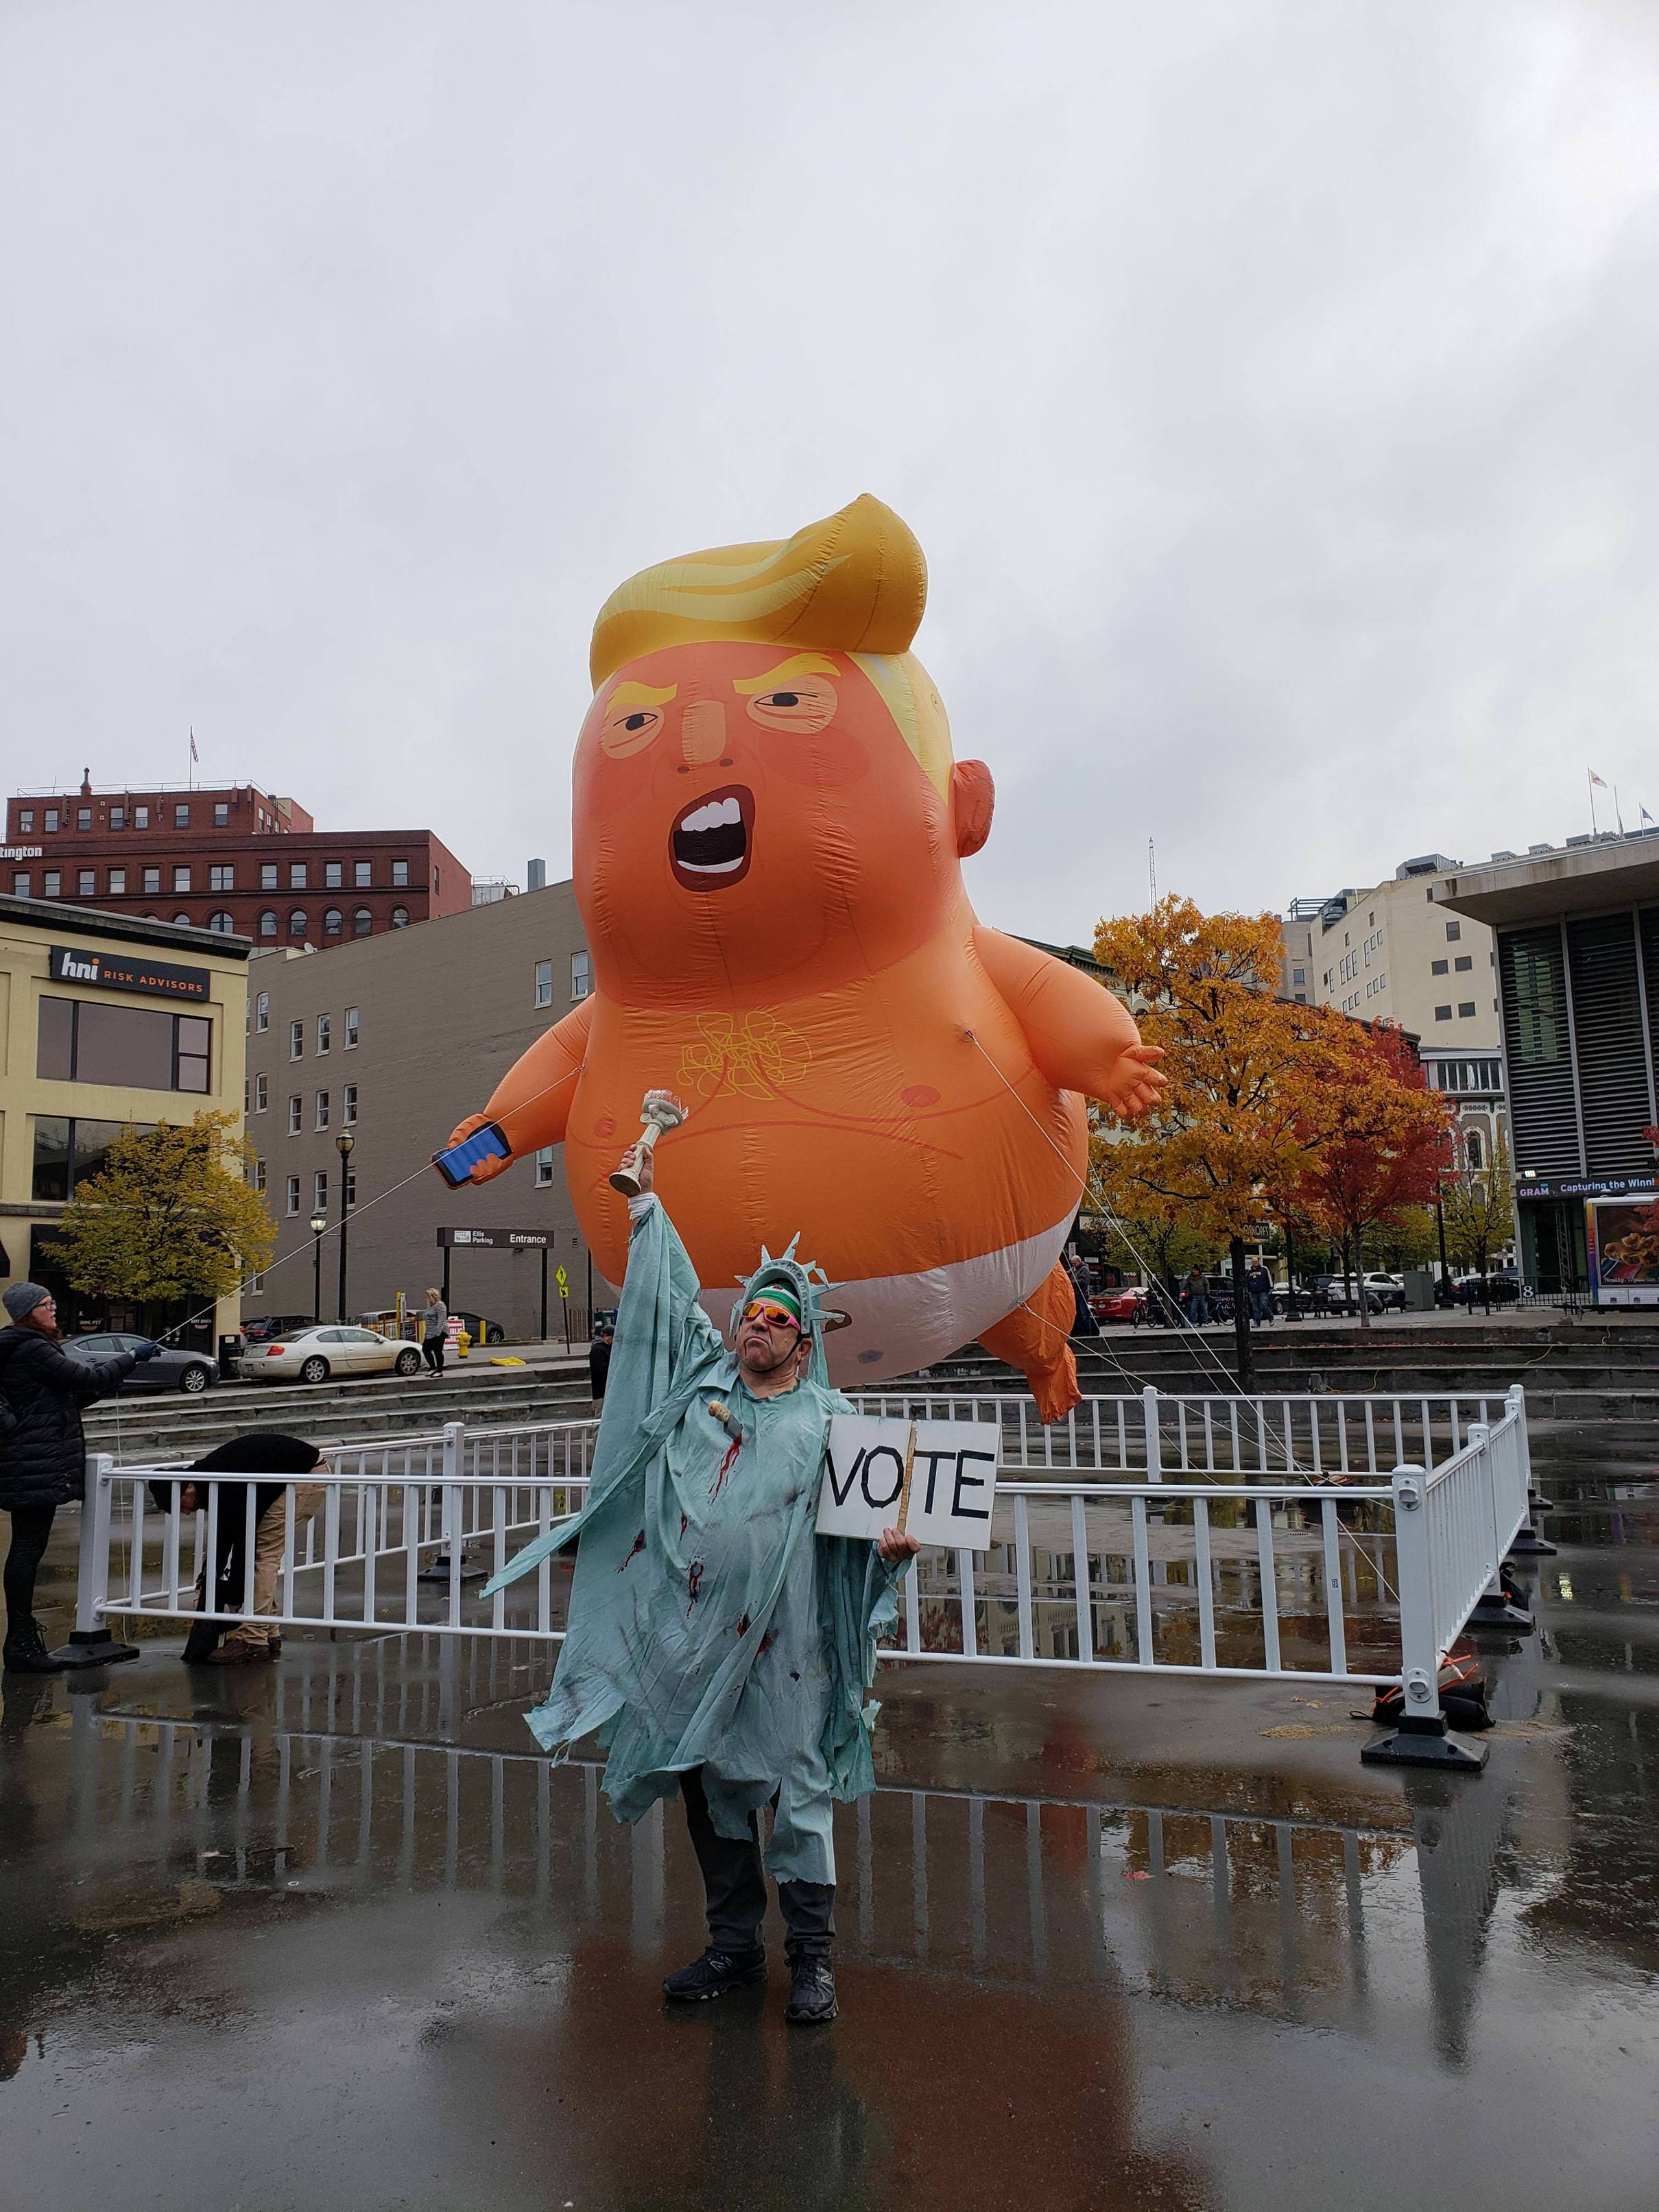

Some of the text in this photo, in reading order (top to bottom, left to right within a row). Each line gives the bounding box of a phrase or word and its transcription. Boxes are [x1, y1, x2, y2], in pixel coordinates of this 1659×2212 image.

[61, 952, 99, 981] hni
[104, 970, 203, 993] RISK ADVISORS
[1560, 1181, 1606, 1193] Capturing
[1609, 1178, 1625, 1189] the
[1520, 1187, 1549, 1197] GRAM
[473, 1236, 493, 1245] Parking
[510, 1234, 547, 1244] Entrance
[1523, 1285, 1533, 1297] 8
[449, 1327, 464, 1336] UBLIC
[825, 1445, 995, 1519] VOTE
